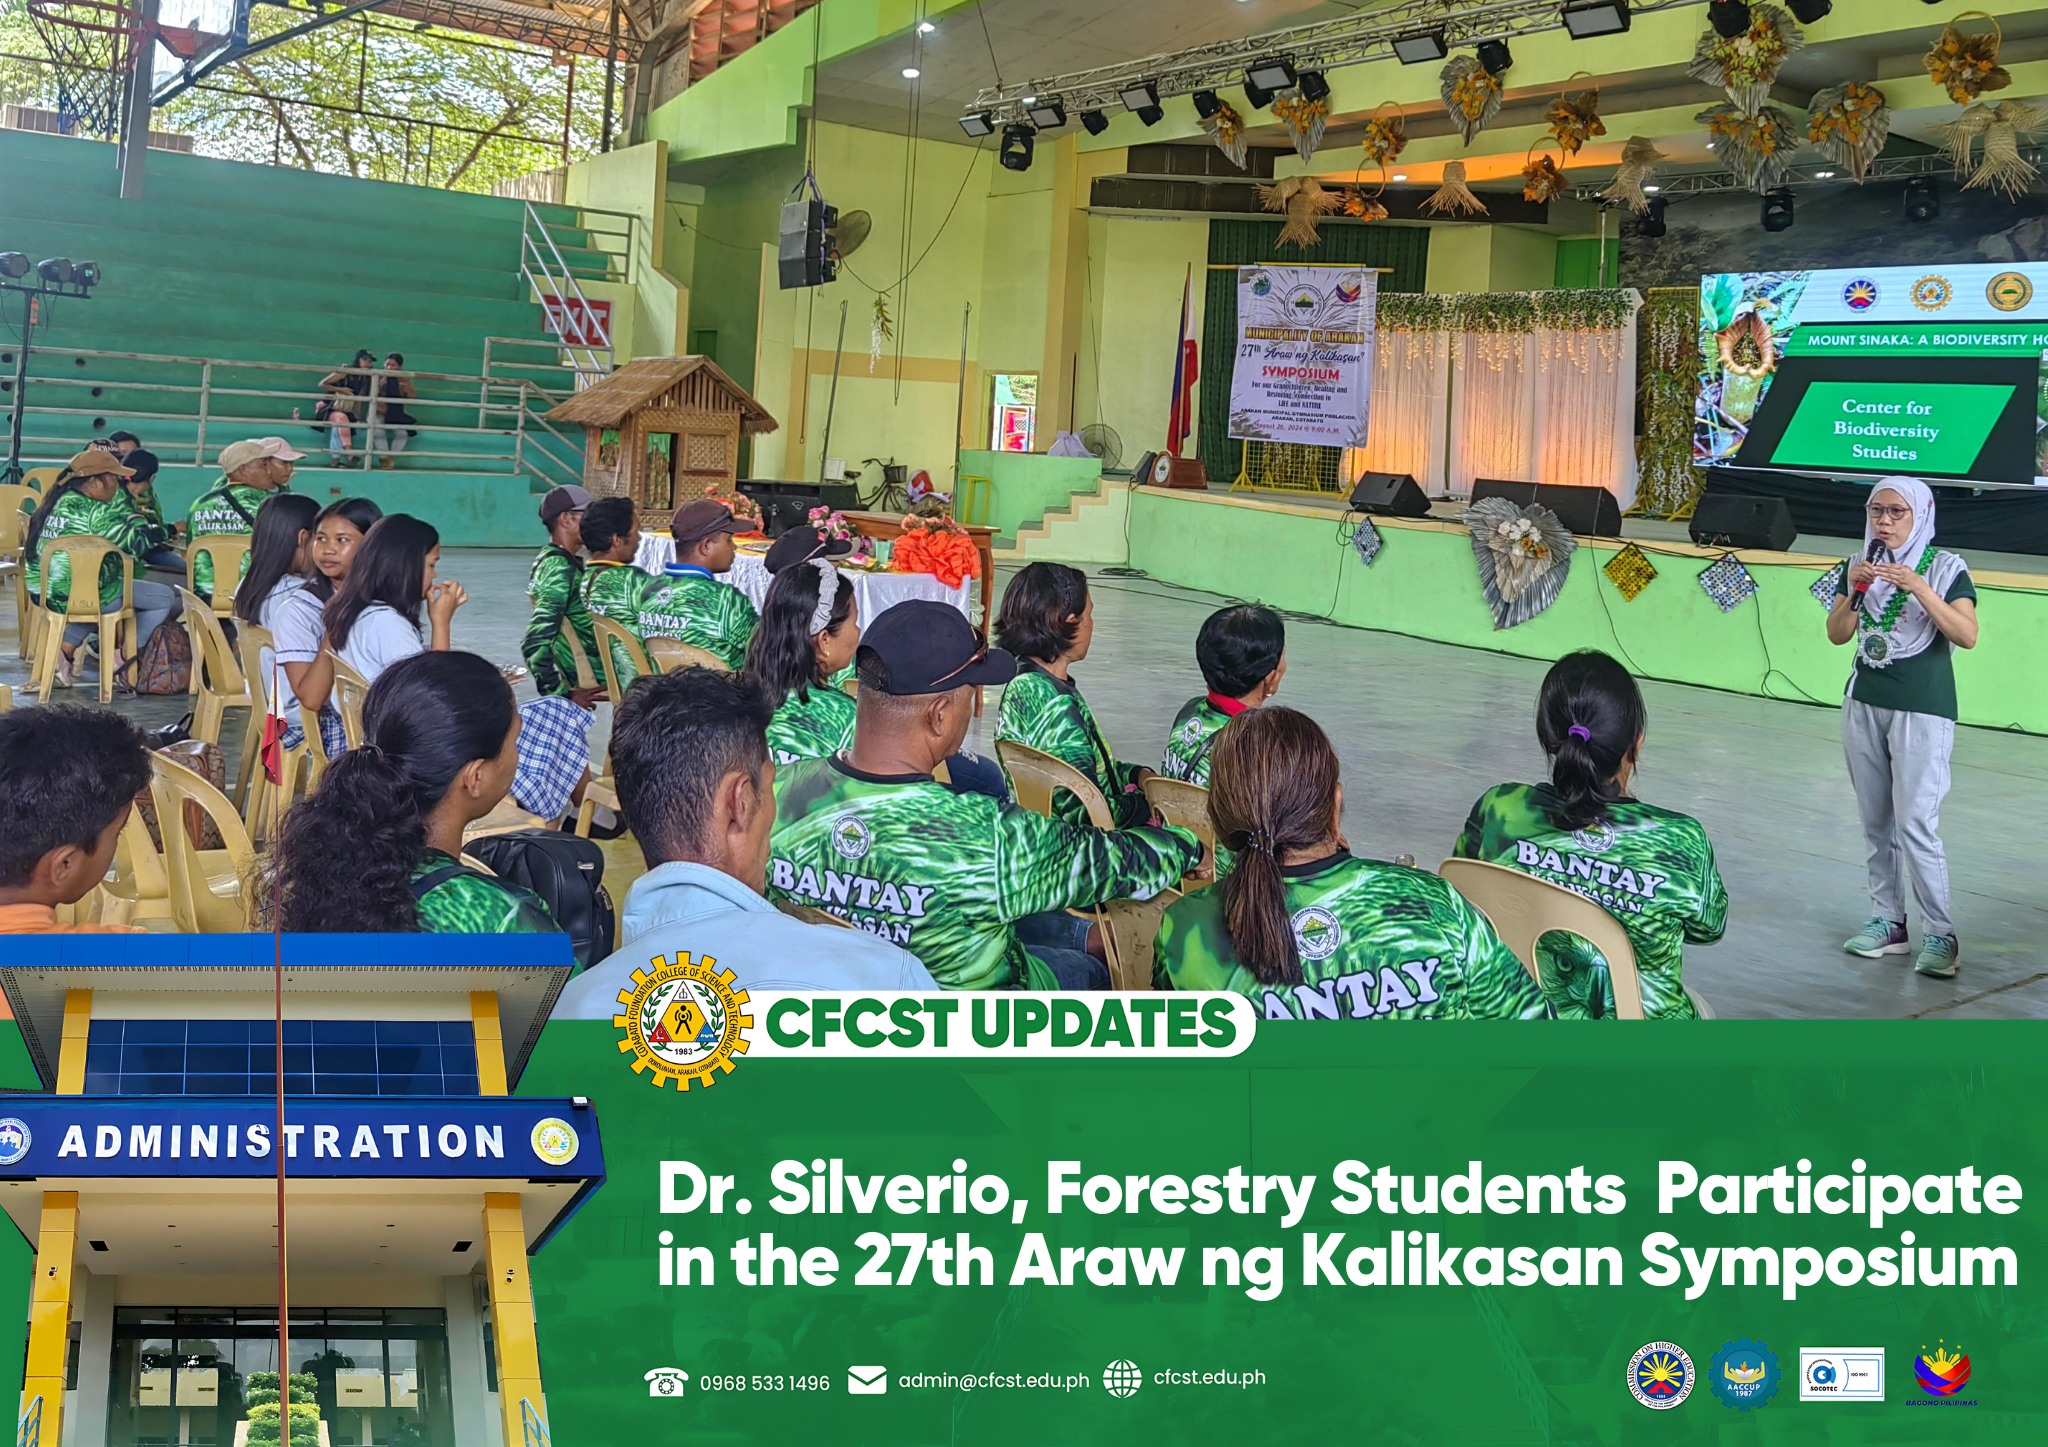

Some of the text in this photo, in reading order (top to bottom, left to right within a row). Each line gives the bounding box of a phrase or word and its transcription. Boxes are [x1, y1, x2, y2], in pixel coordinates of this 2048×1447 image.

[544, 304, 607, 338] EXIT
[1245, 327, 1364, 344] MUNICIPALITY OF ARAKAN
[1808, 335, 1856, 346] MOUNT
[1859, 335, 1914, 346] SINAKA:
[1917, 334, 1928, 346] A
[1932, 334, 2029, 346] BIODIVERSITY
[1262, 365, 1340, 379] SYMPOSIUM
[1290, 400, 1300, 408] and
[1842, 399, 1933, 416] Center for
[1833, 421, 1940, 442] Biodiversity
[1852, 444, 1917, 461] Studies
[198, 522, 244, 531] KALIKASAN
[639, 611, 691, 630] BANTAY
[1516, 839, 1665, 898] BANTAY
[771, 858, 935, 917] BANTAY
[57, 1124, 505, 1158] ADMINISTRATION
